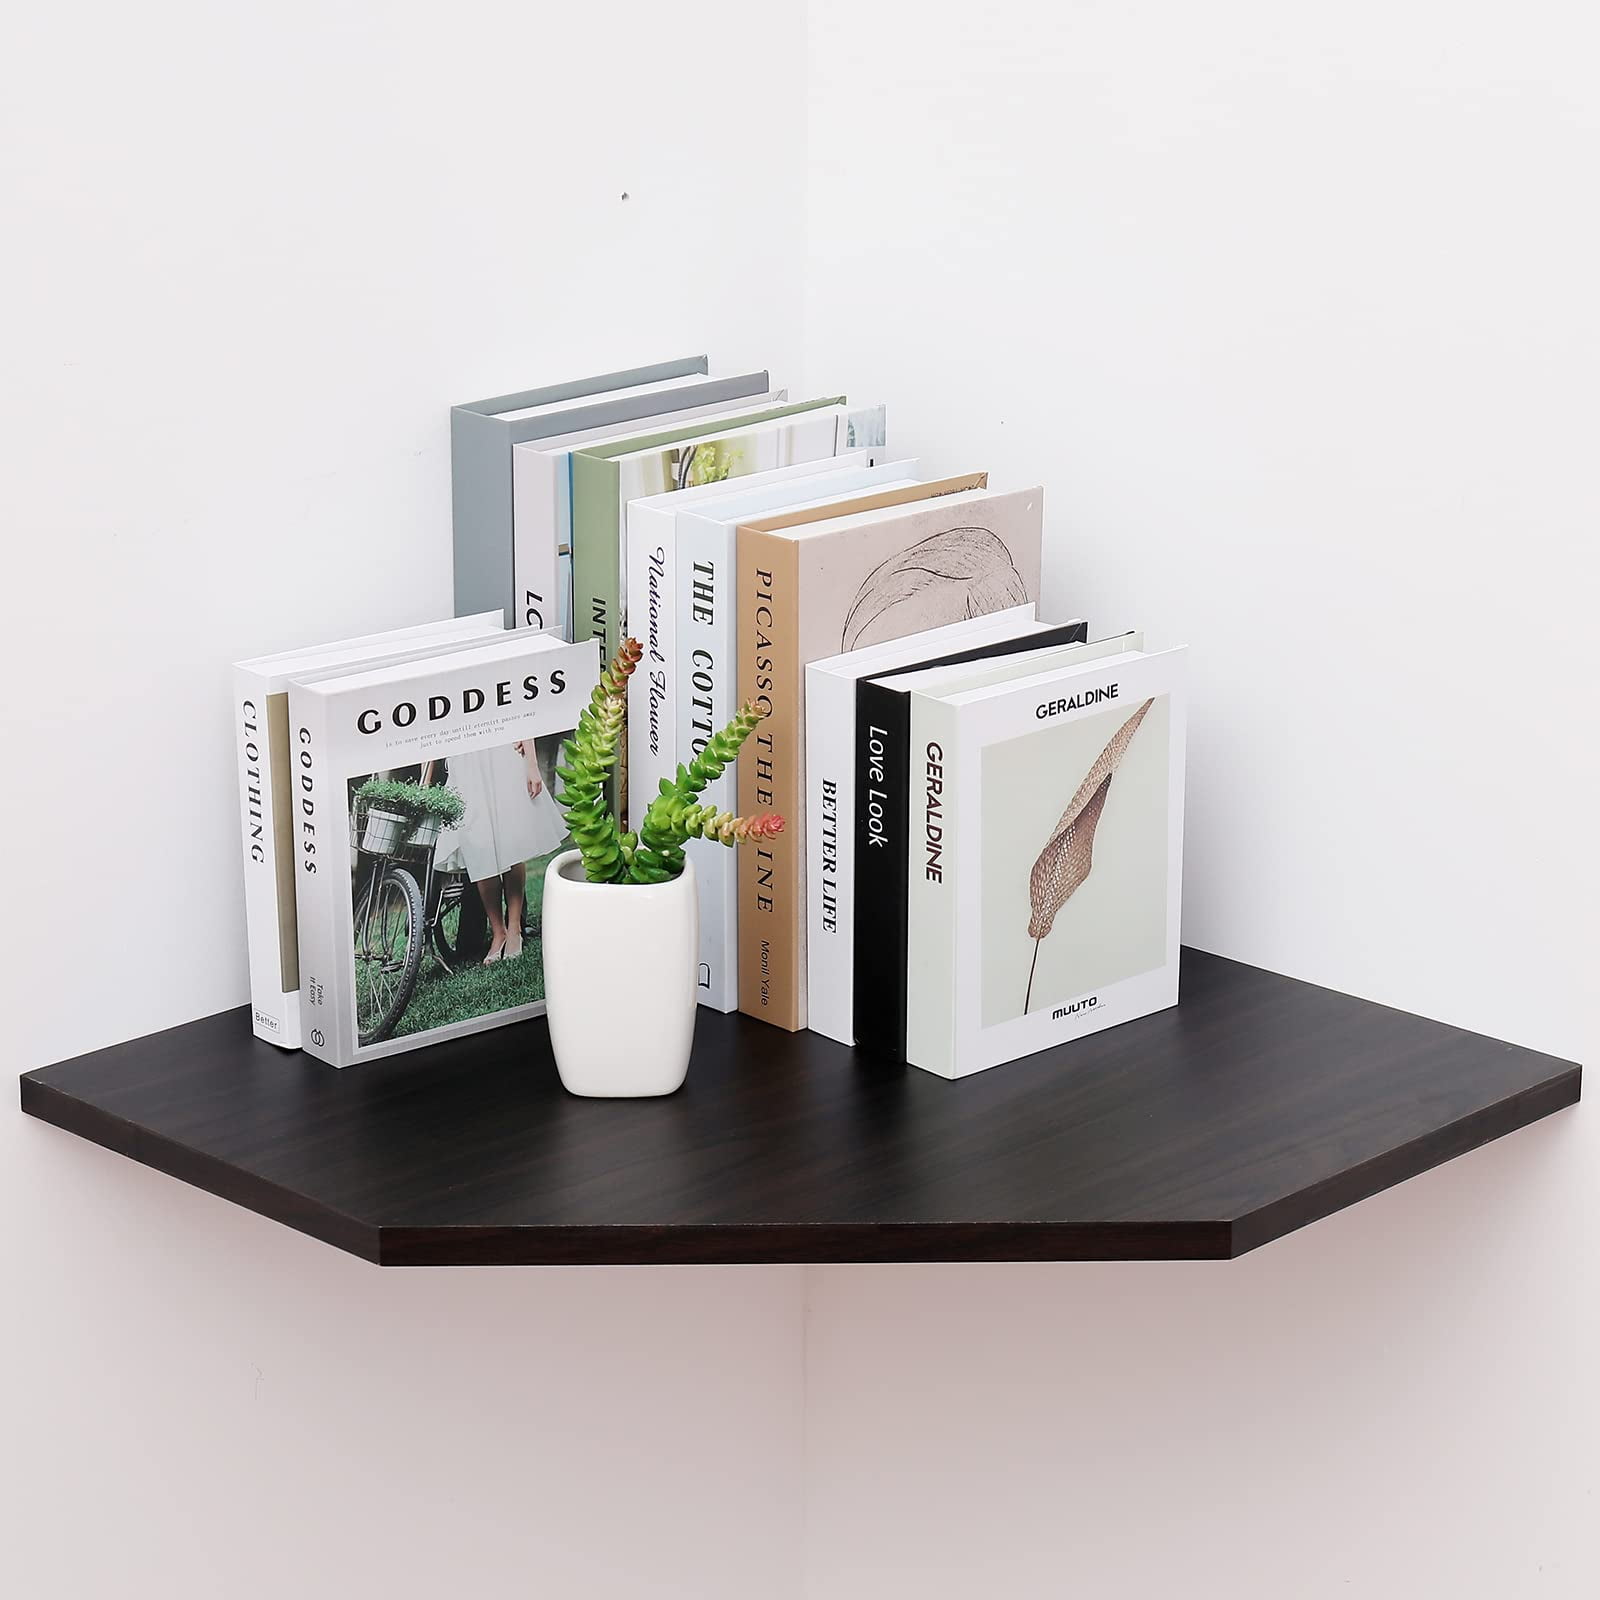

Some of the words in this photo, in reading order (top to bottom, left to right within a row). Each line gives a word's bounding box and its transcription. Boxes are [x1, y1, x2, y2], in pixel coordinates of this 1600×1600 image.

[649, 547, 665, 663] National
[692, 561, 714, 626] THE
[756, 568, 773, 718] PICASSO
[357, 669, 567, 735] GODDESS
[649, 670, 666, 757] Flower
[691, 649, 714, 783] COTTO
[1036, 683, 1119, 719] GERALDINE
[243, 700, 264, 863] CLOTHING
[756, 734, 773, 805] THE
[869, 725, 888, 783] Love
[300, 727, 316, 874] GODDESS
[822, 778, 837, 873] BETTER
[869, 788, 888, 848] Look
[925, 741, 943, 884] GERALDINE
[757, 845, 773, 913] INE
[822, 878, 837, 935] LIFE
[255, 1011, 278, 1030] Better
[760, 979, 770, 1006] Yale
[1052, 996, 1097, 1020] MUUTO
